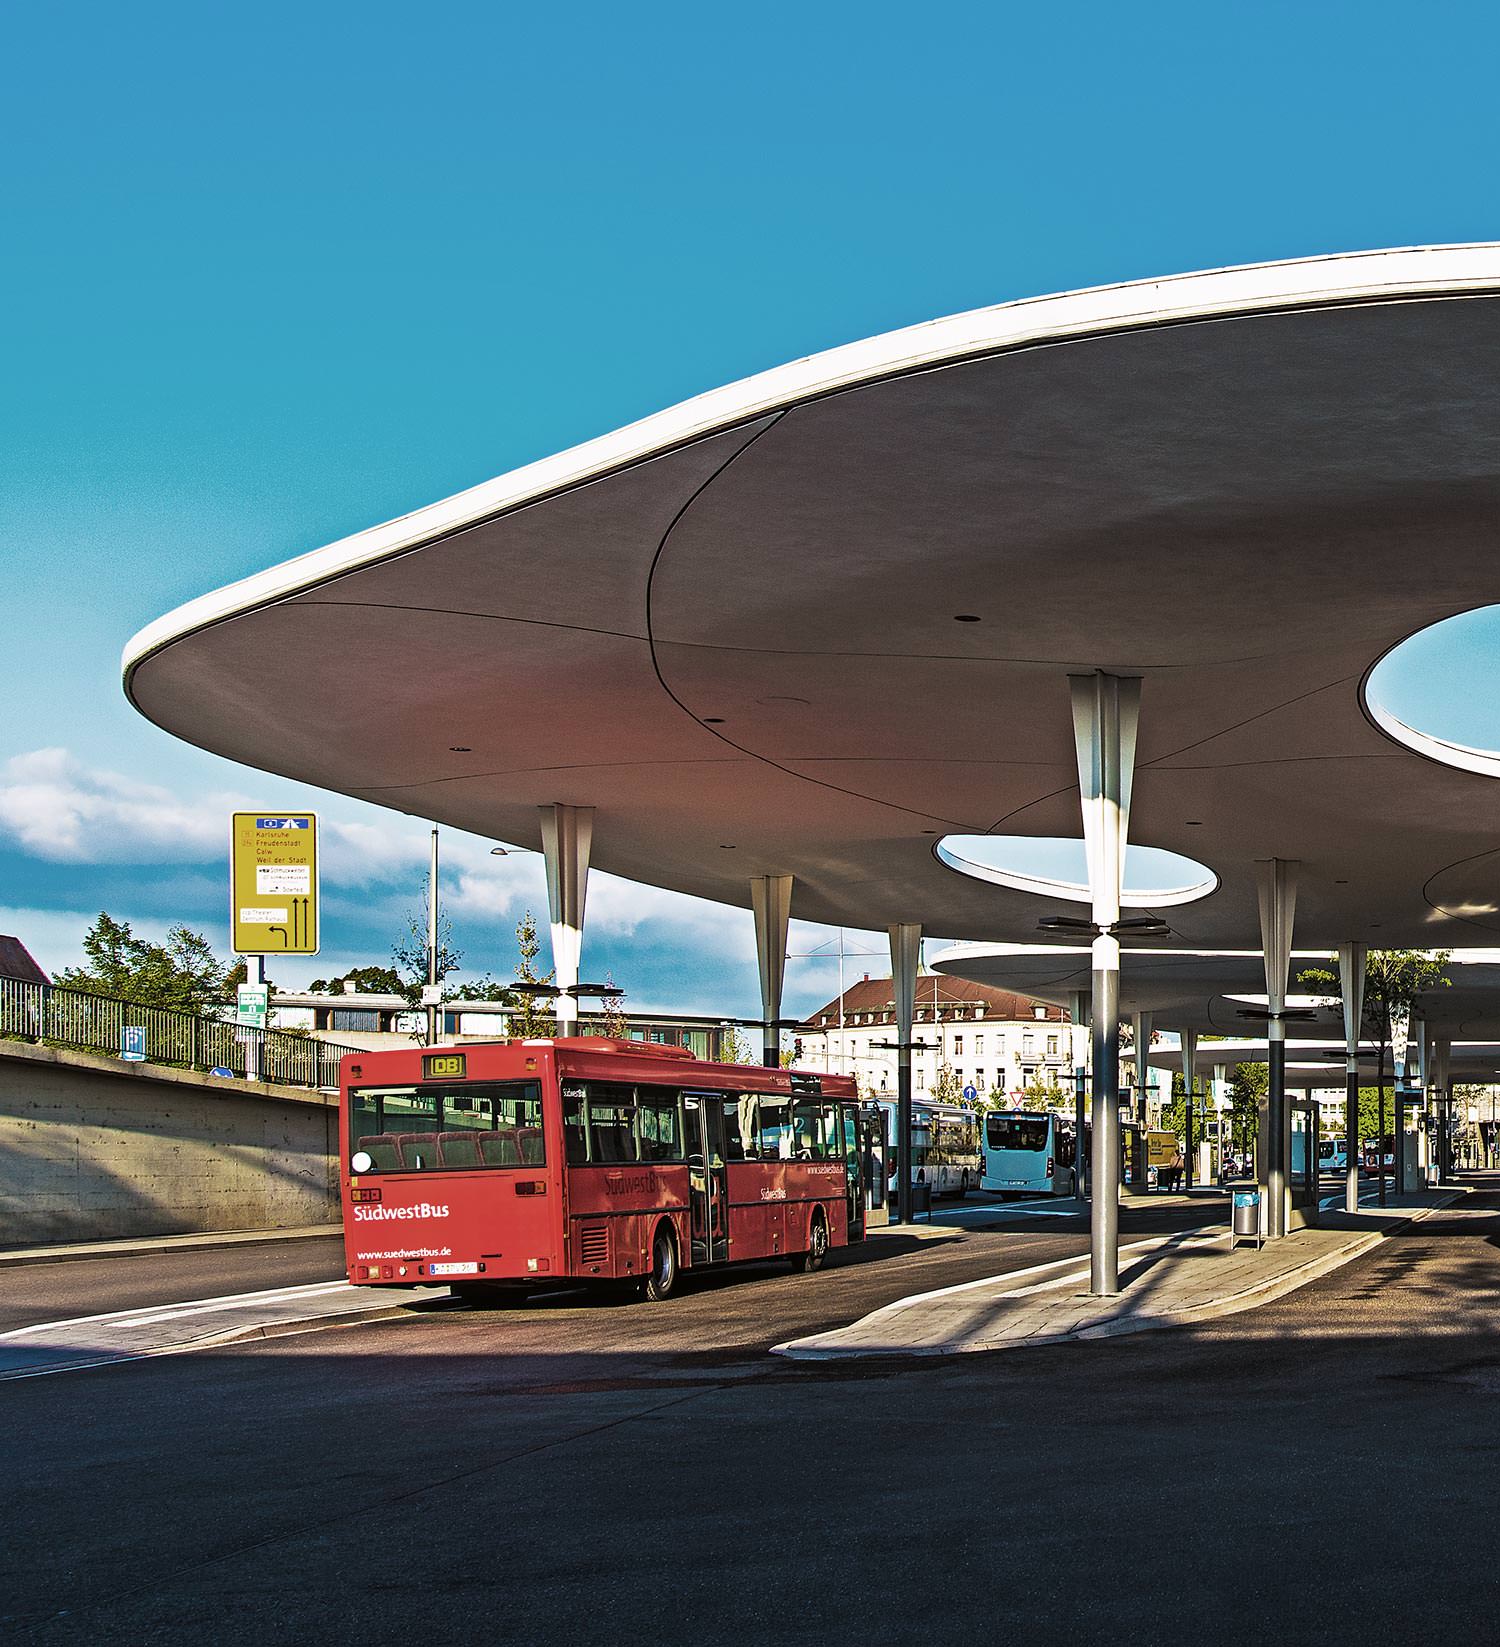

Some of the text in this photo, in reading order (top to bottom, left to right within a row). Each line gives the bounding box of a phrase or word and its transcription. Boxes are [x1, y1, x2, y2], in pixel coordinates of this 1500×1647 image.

[434, 1058, 458, 1073] DB
[563, 1088, 587, 1097] SüdwestB
[353, 1203, 450, 1222] SüdwestBus
[357, 1247, 452, 1260] www.suedwestbus.de
